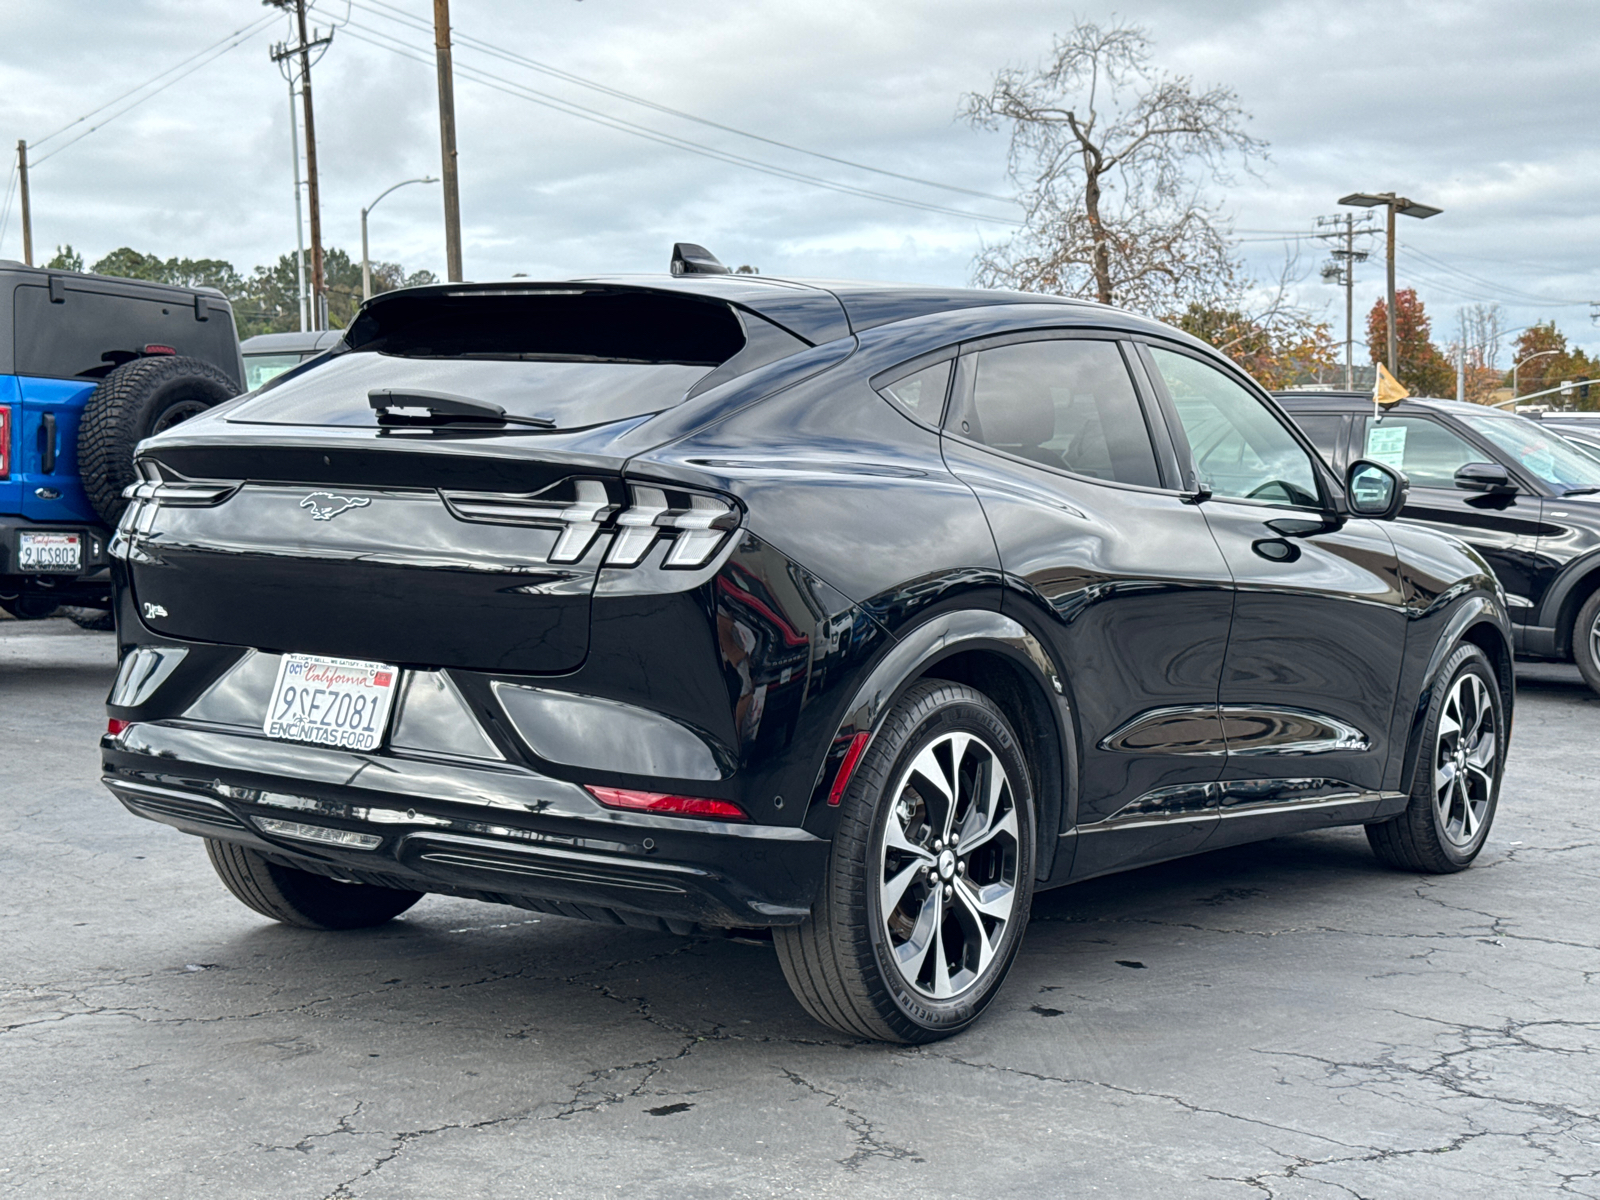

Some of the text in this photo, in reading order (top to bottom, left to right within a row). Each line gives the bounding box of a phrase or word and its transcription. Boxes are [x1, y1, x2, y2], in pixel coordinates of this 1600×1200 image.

[25, 547, 76, 565] 9JCS803
[305, 664, 374, 689] California
[277, 686, 379, 733] 9SEZ081
[341, 730, 374, 749] FORD
